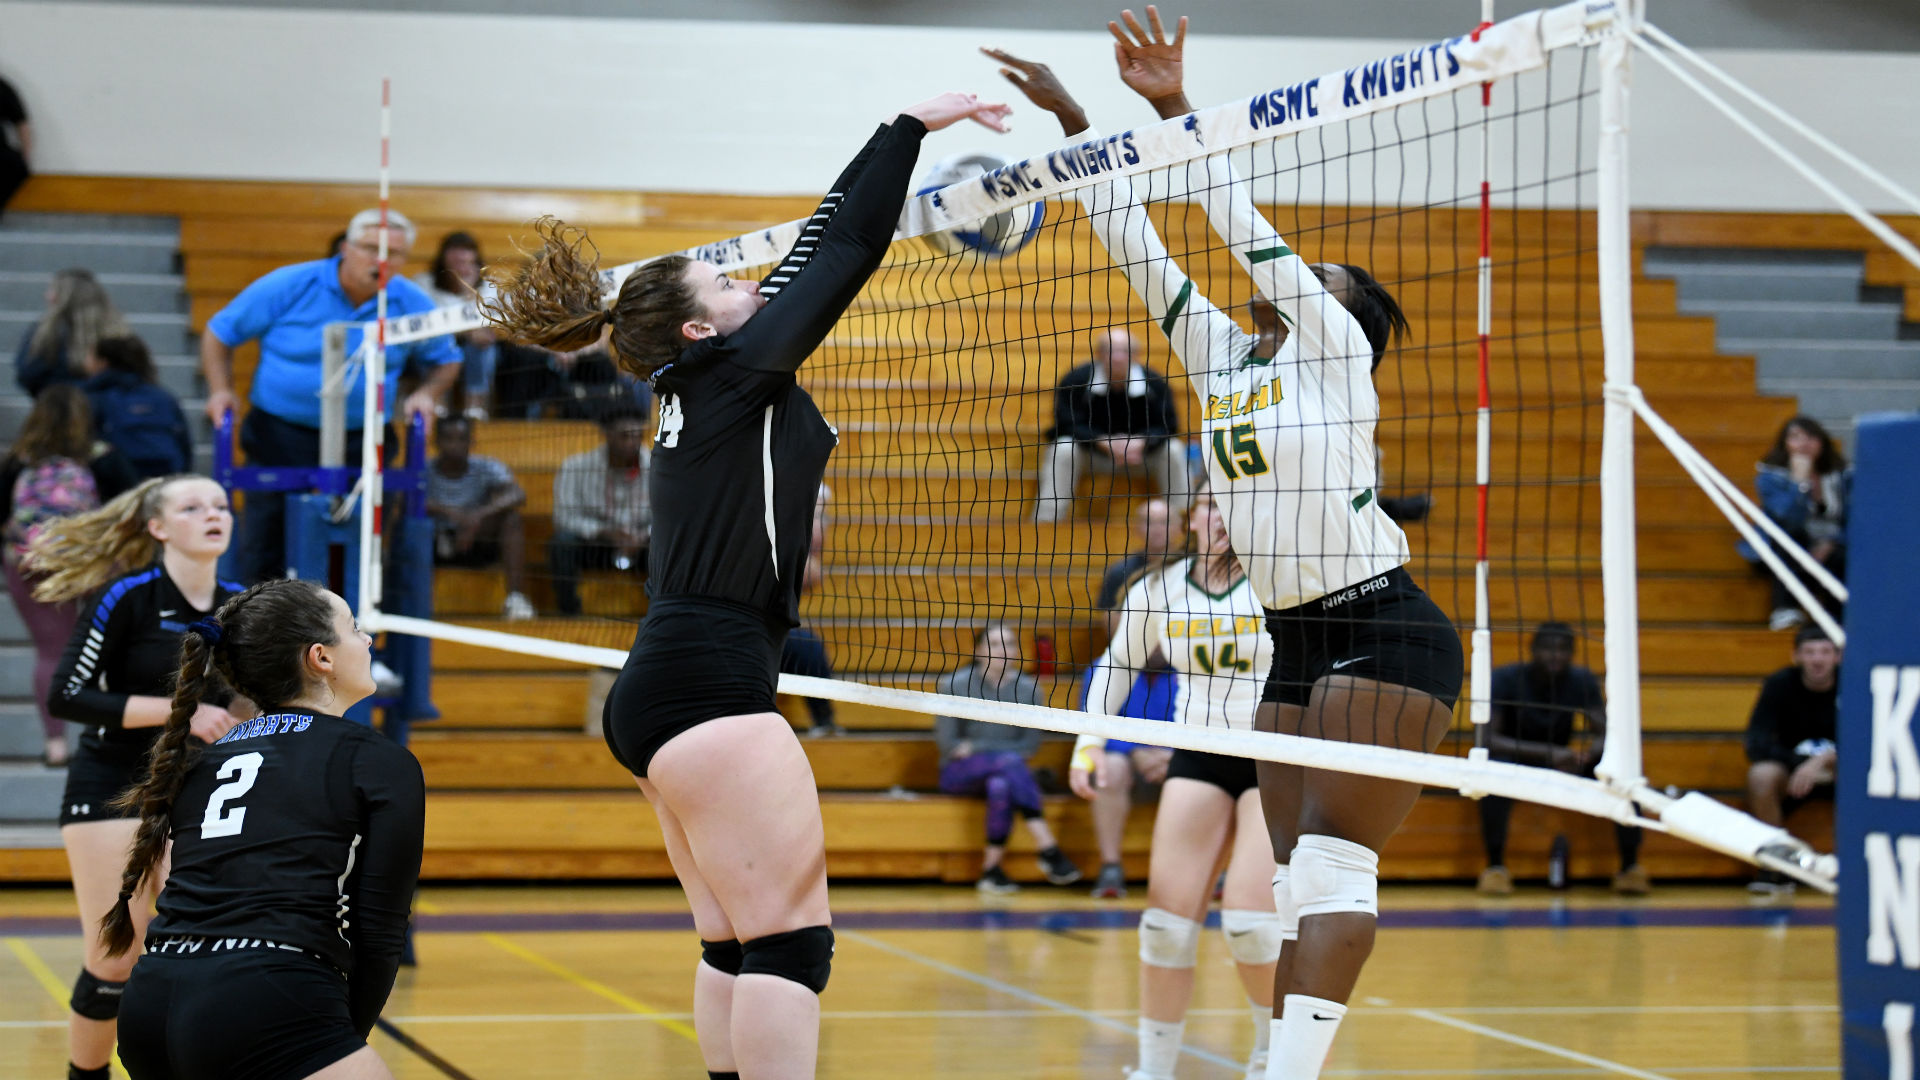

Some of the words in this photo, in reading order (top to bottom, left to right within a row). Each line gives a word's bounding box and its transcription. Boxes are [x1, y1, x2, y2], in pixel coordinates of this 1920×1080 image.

[1343, 36, 1464, 108] KNIGHTS
[1047, 129, 1141, 183] KNIGHTS
[1203, 375, 1284, 421] DELHI
[1212, 420, 1270, 482] 15
[1321, 588, 1359, 611] NIKE
[1360, 576, 1390, 597] PRO
[1165, 615, 1266, 639] DELH
[1194, 642, 1252, 675] 14
[215, 713, 314, 746] KNIGHTS
[201, 752, 264, 840] 2
